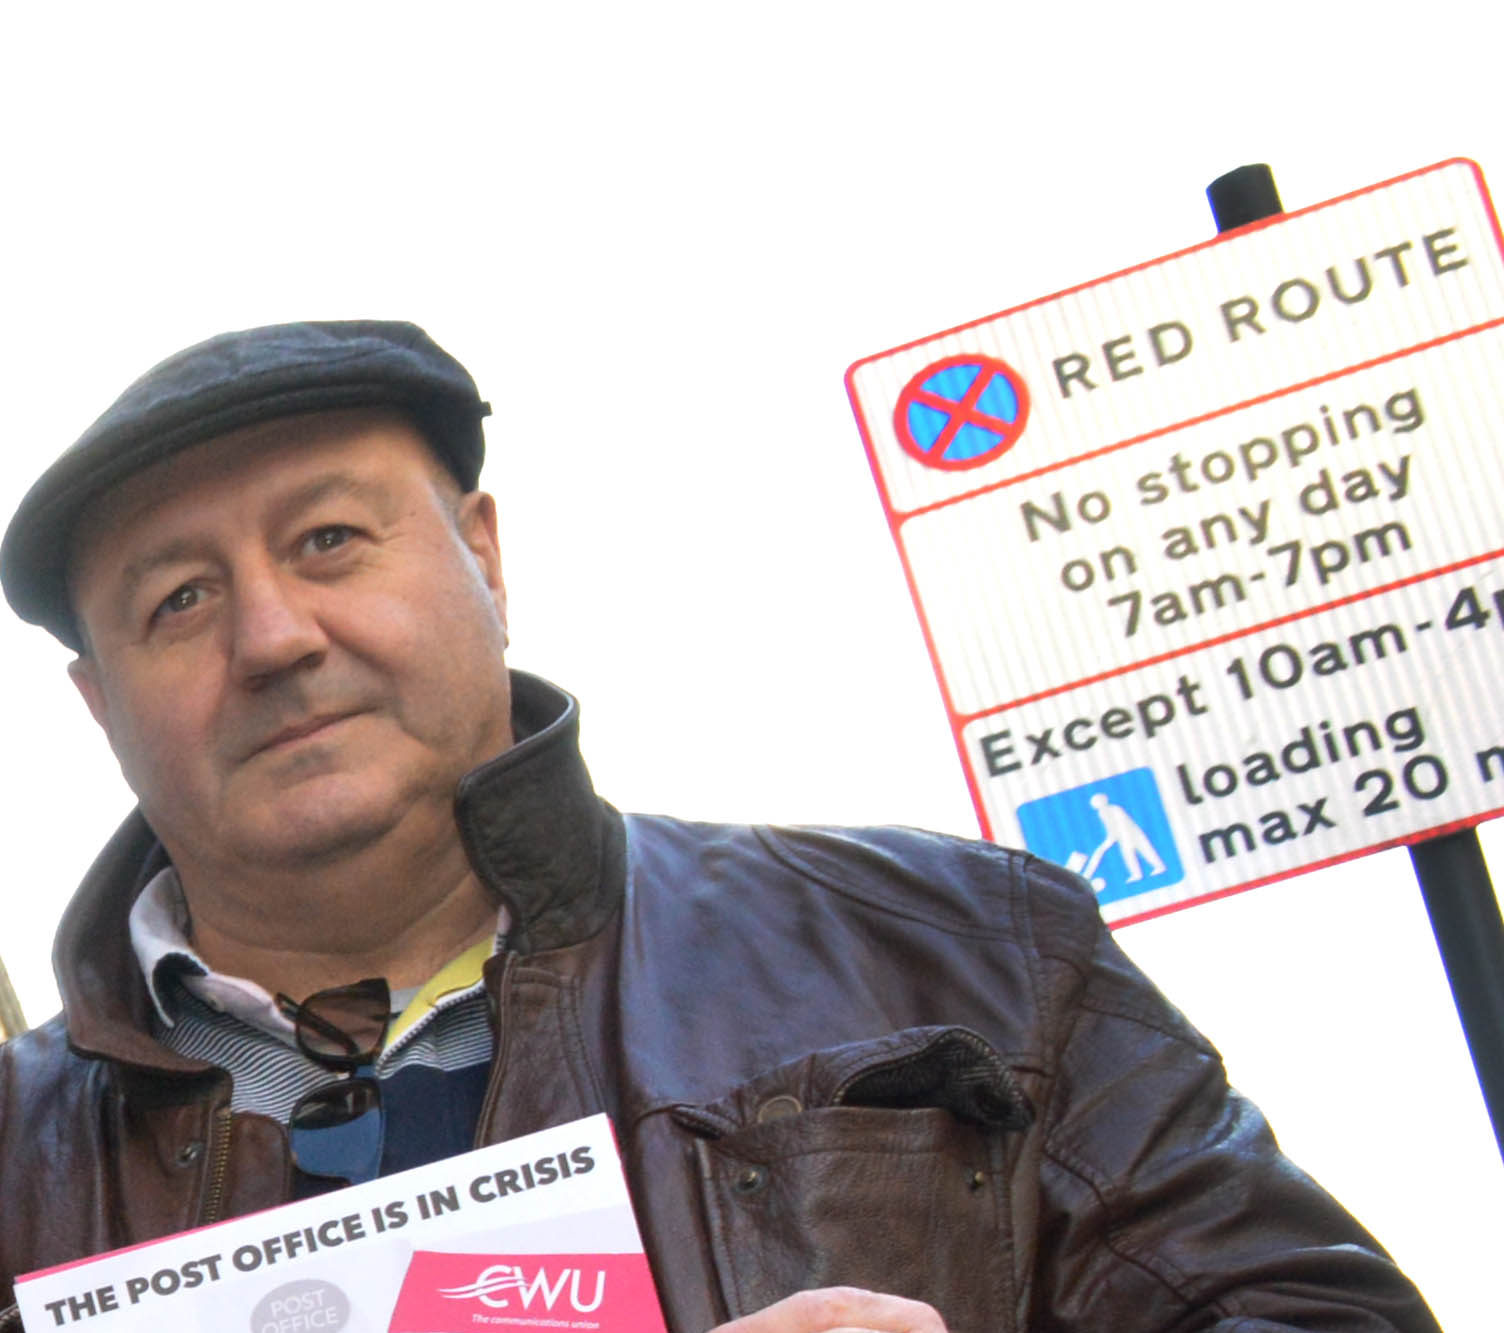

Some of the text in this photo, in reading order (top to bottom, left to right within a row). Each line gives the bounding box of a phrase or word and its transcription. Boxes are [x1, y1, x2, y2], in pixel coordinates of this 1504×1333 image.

[1052, 228, 1471, 399] RED ROUTE
[1019, 387, 1427, 542] No stopping
[1061, 454, 1416, 593] on any day
[1108, 517, 1414, 638] 7am-7pm
[979, 586, 1504, 779] Except 10am-4
[1175, 705, 1427, 806] loading
[1198, 793, 1338, 864] max
[1354, 752, 1451, 818] 20
[45, 1145, 597, 1327] THE POST OFFICE IS IN CRISIS
[476, 1264, 606, 1313] CWU
[269, 1287, 326, 1319] POST
[472, 1313, 489, 1324] The
[490, 1315, 570, 1329] communications
